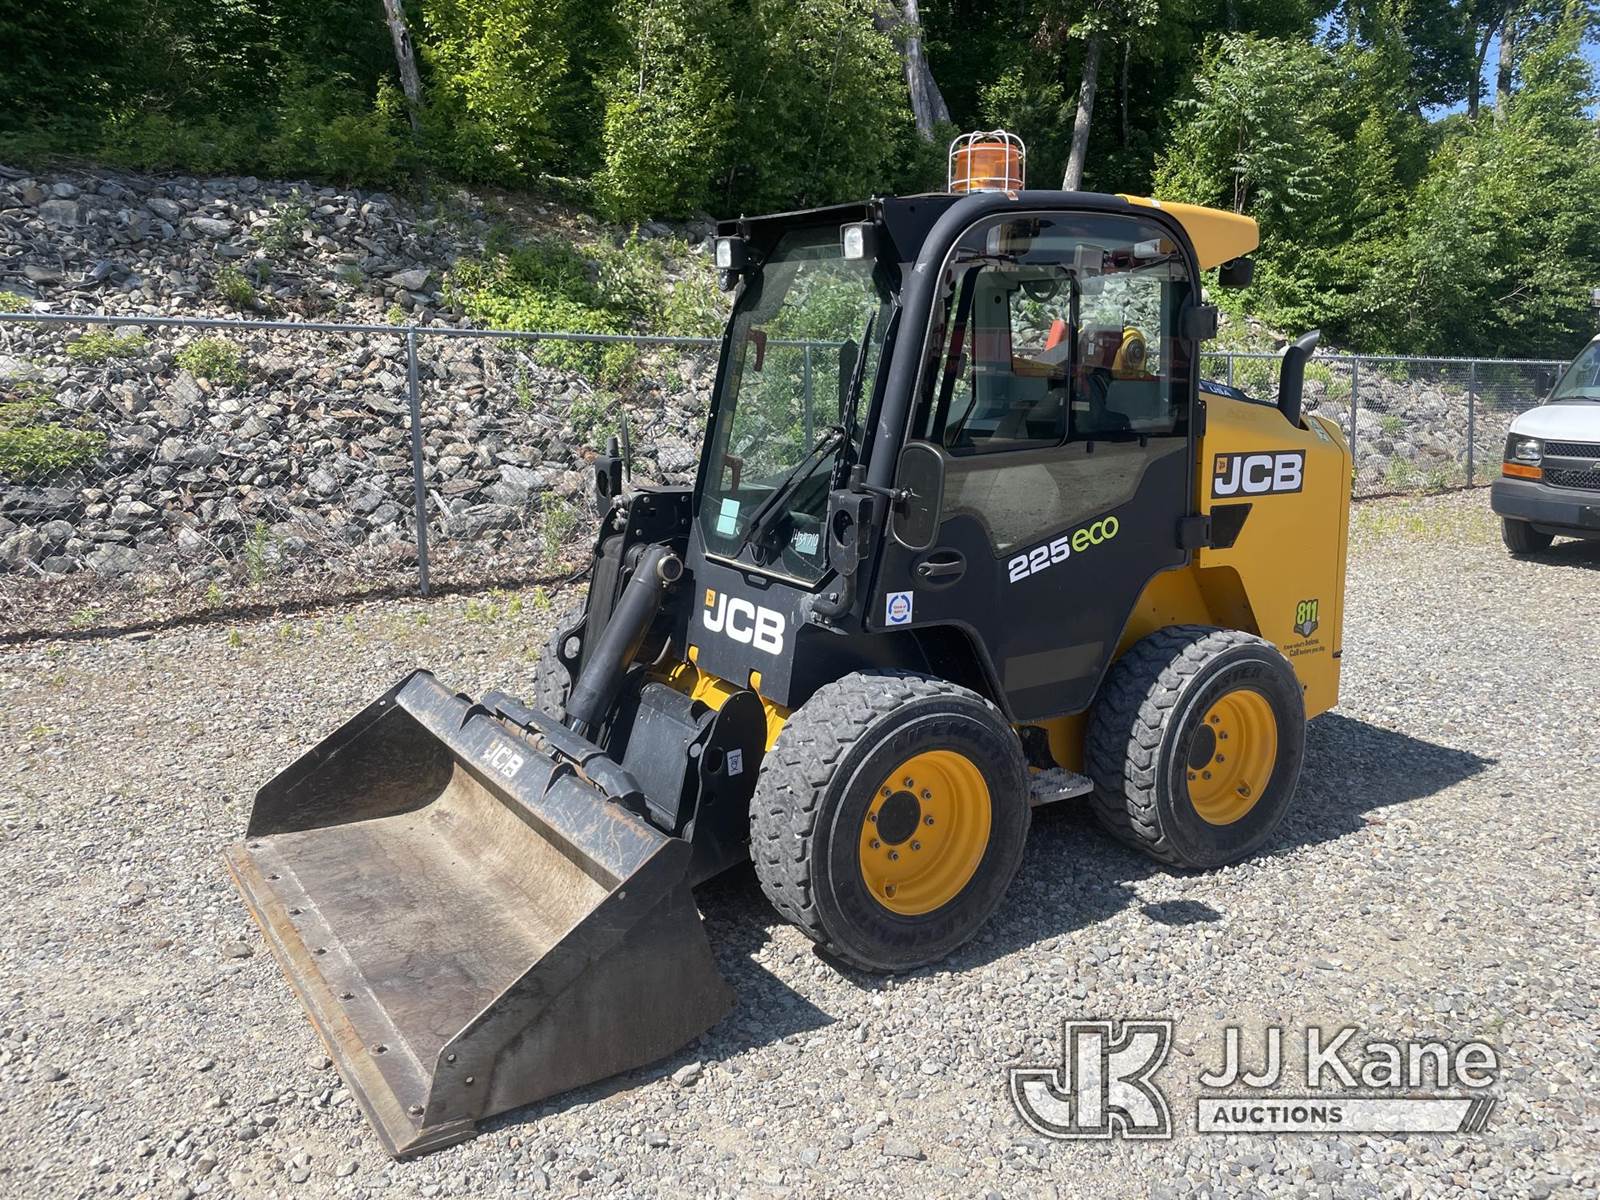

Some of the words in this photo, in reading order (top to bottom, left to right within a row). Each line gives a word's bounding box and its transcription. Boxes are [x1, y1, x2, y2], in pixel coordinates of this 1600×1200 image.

[1215, 453, 1303, 495] JCB
[1008, 535, 1071, 584] 225
[1071, 514, 1120, 553] eco
[702, 591, 786, 656] JCB
[1296, 600, 1318, 624] 811
[483, 742, 523, 778] JCB
